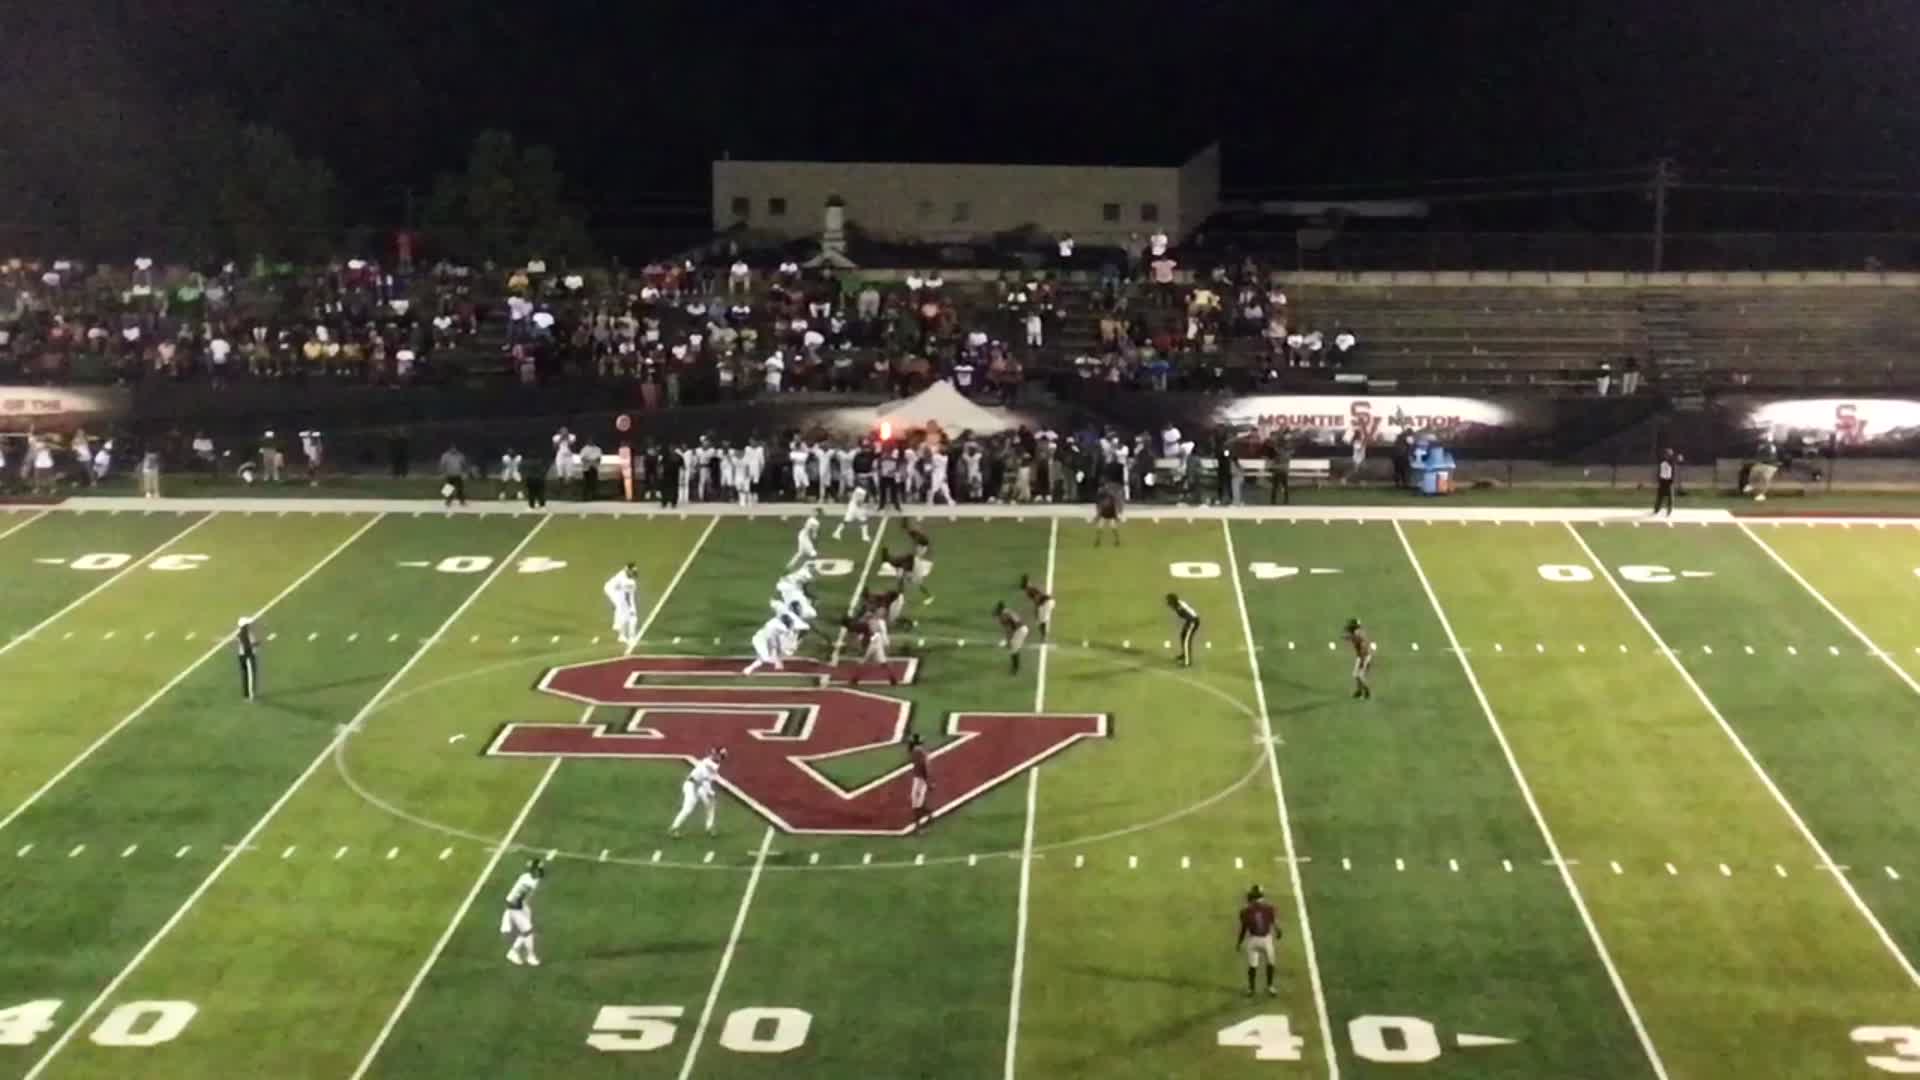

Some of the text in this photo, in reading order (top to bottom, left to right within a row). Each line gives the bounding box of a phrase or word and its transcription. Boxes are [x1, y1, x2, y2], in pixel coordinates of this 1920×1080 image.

[1257, 413, 1345, 427] MOUNTIE
[1387, 414, 1461, 428] NATION
[484, 655, 1109, 836] SV
[585, 1004, 814, 1053] 50
[1216, 1013, 1442, 1063] 40
